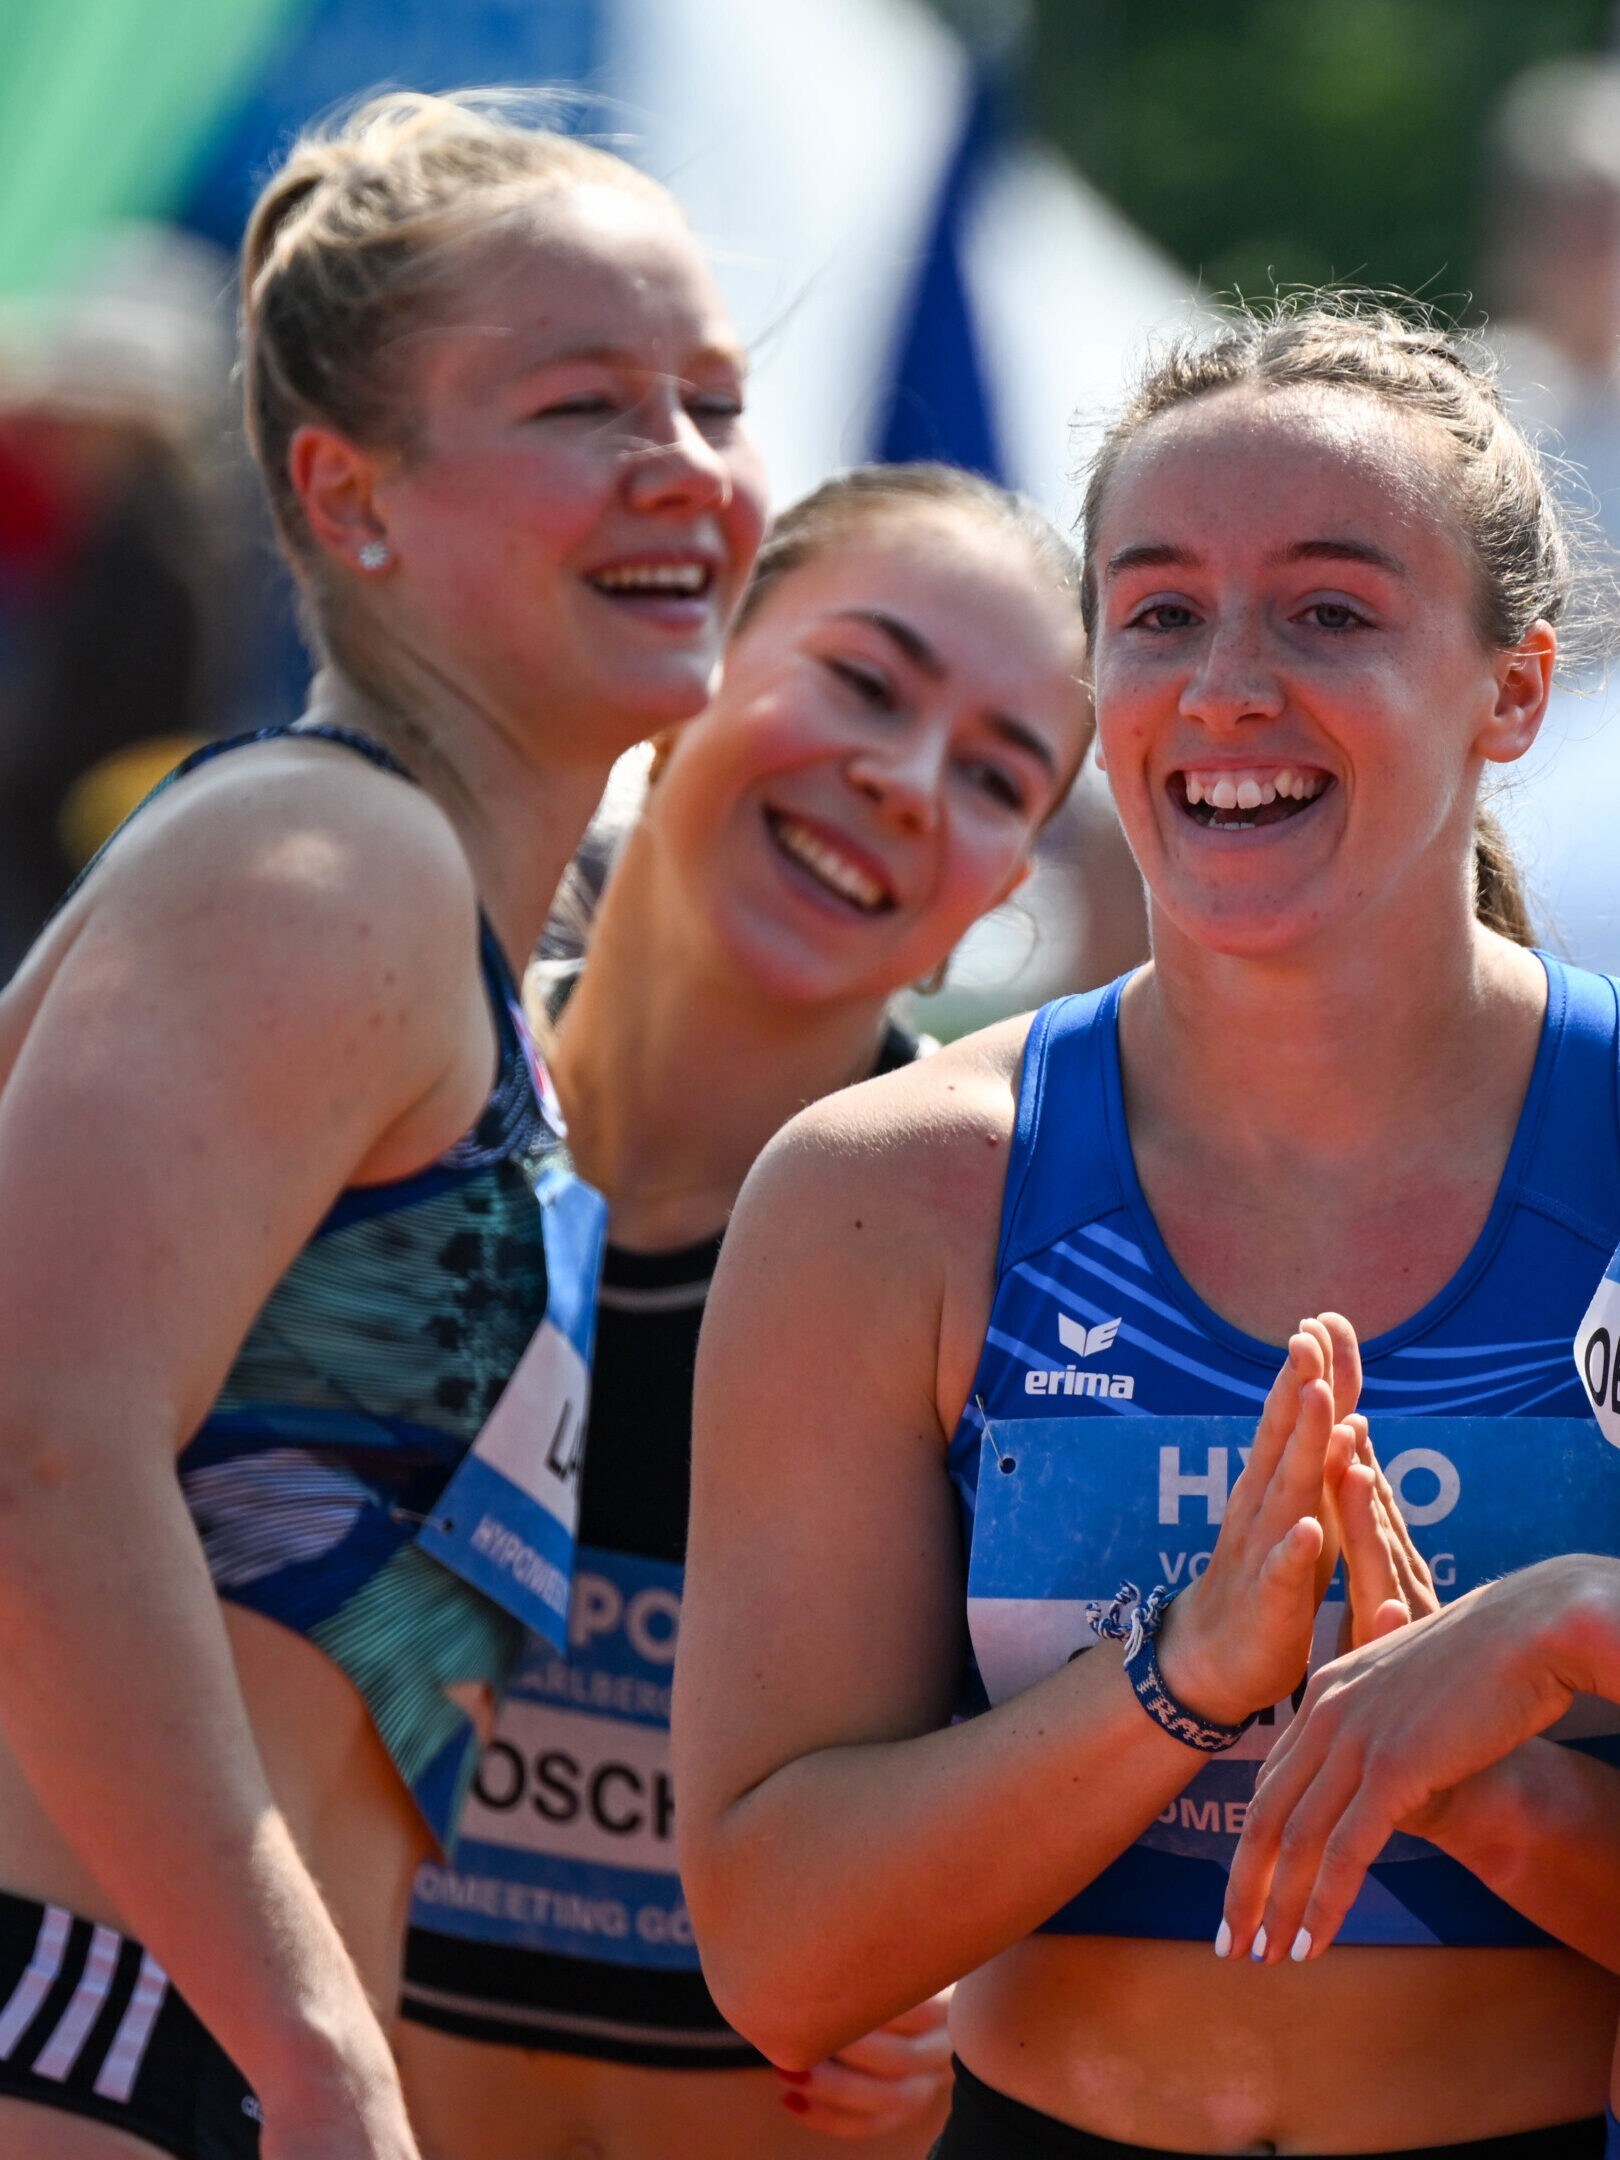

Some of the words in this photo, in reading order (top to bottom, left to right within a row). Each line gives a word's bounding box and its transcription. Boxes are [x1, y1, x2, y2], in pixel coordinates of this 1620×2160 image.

[1024, 1364, 1135, 1400] erima
[544, 1397, 583, 1482] L
[1158, 1446, 1461, 1526] HO
